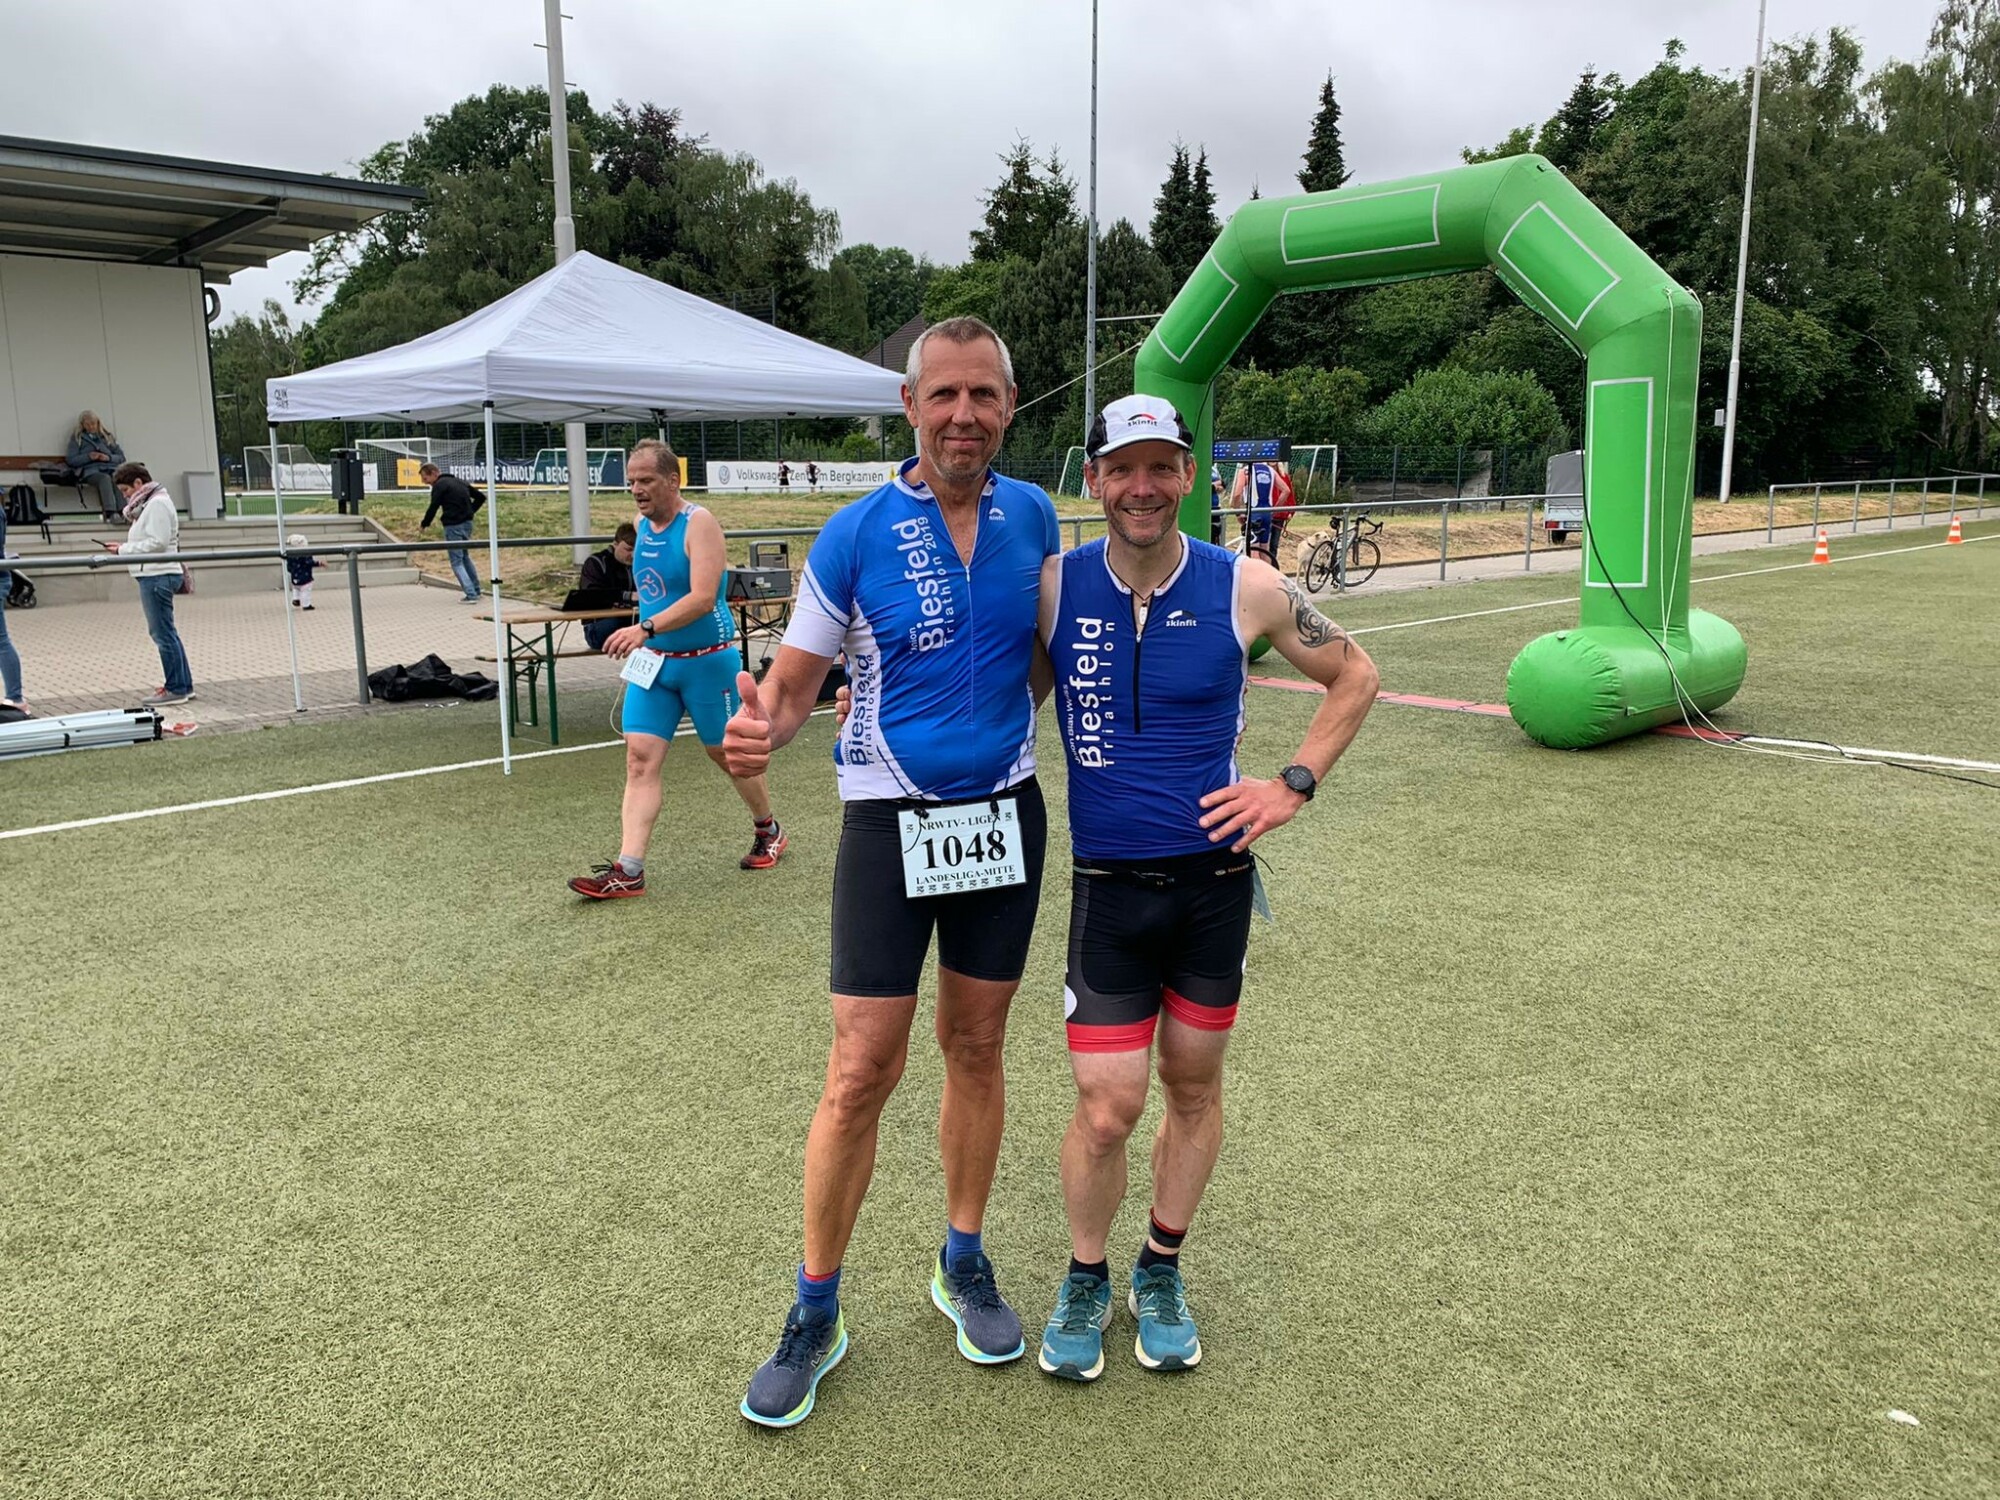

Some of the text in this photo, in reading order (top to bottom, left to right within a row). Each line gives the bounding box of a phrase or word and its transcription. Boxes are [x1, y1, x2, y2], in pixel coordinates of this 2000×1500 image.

[1127, 419, 1158, 427] skinfit
[449, 462, 500, 481] REIFENBÖE
[501, 465, 535, 481] ARNOLD
[545, 466, 602, 484] BERGEN
[736, 468, 884, 485] Volkswag Zentm Bergkamen
[891, 518, 945, 652] Biesfeld
[917, 516, 955, 647] Triathlon 2019
[1165, 619, 1198, 628] skinfit
[629, 655, 654, 676] 1033
[849, 654, 870, 766] Biesfeld
[1069, 617, 1103, 768] Biesfeld
[1098, 622, 1116, 768] Triathlon
[864, 687, 875, 766] Triathlon
[920, 829, 1007, 870] 1048
[916, 864, 1015, 885] LANDESLIGA-MITTE
